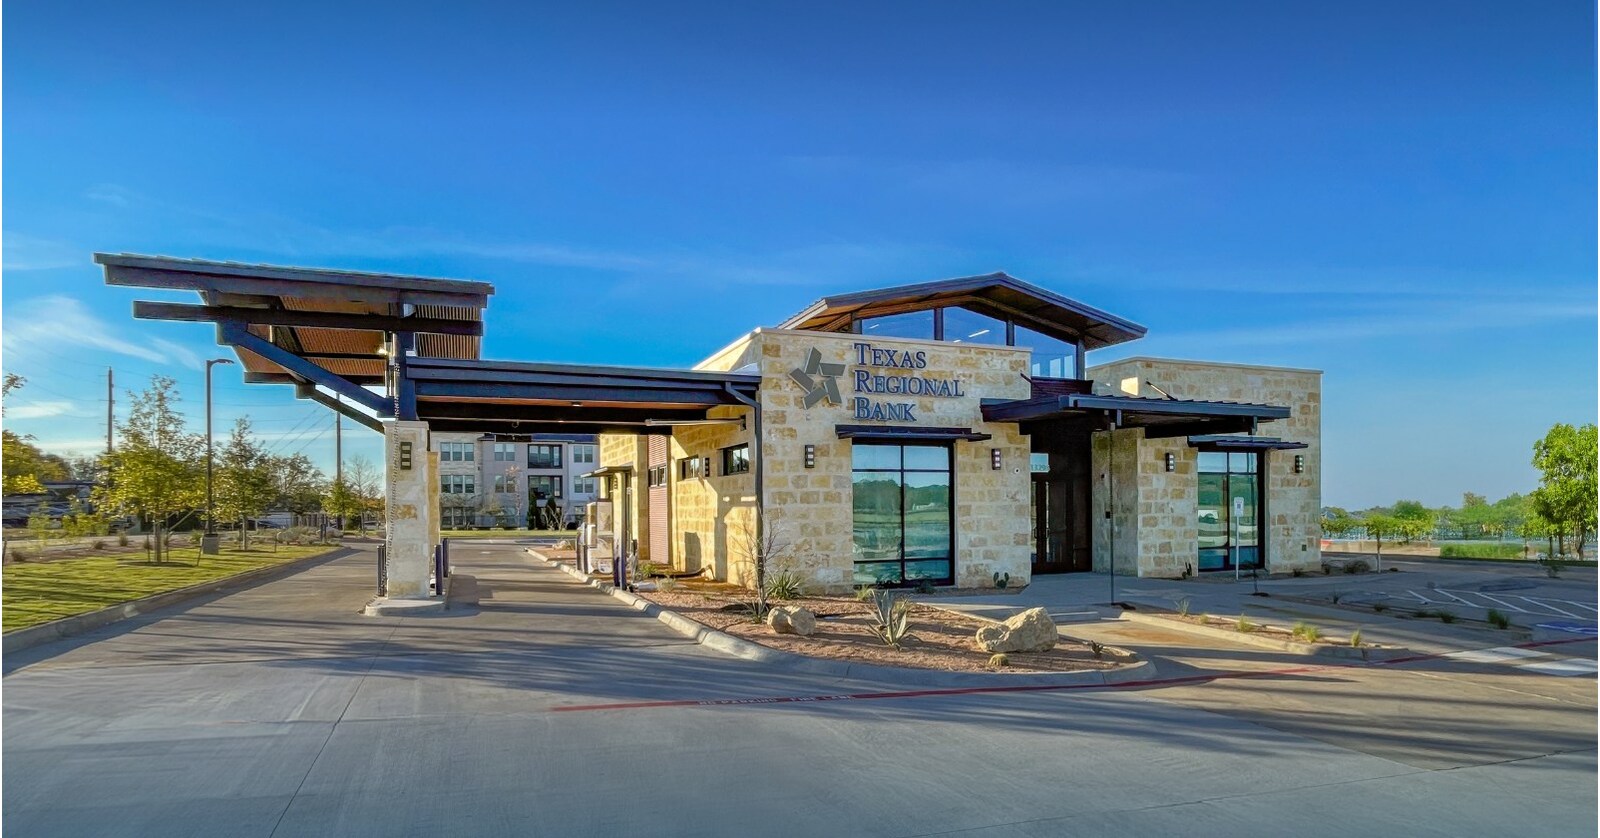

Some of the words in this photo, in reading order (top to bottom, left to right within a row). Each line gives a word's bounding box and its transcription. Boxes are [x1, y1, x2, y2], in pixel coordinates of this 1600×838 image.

[854, 342, 927, 369] TEXAS
[854, 369, 965, 397] REGIONAL
[854, 396, 917, 421] BANK
